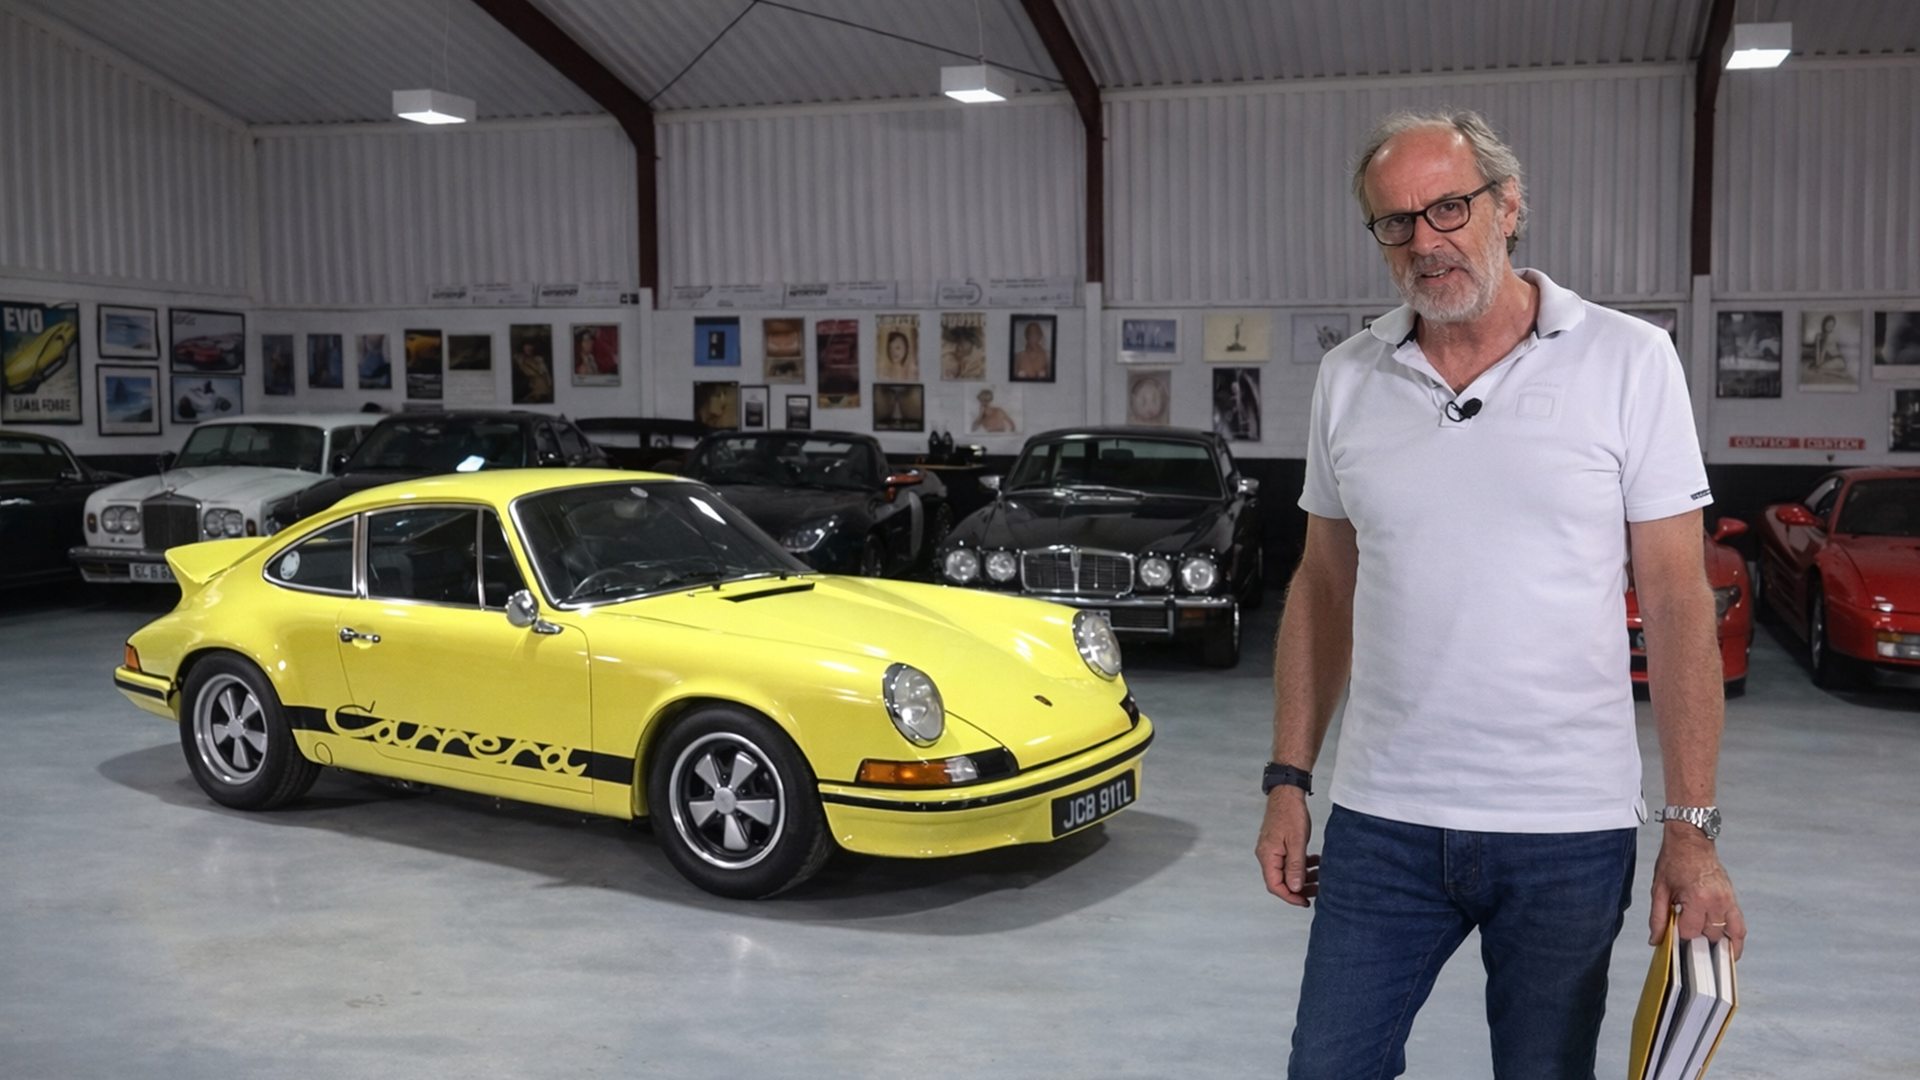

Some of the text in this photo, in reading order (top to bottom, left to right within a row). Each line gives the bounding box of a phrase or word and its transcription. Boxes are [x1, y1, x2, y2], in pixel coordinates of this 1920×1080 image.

[3, 307, 43, 333] EVO
[325, 700, 587, 777] Carrera
[1063, 779, 1132, 829] JCB 911L
